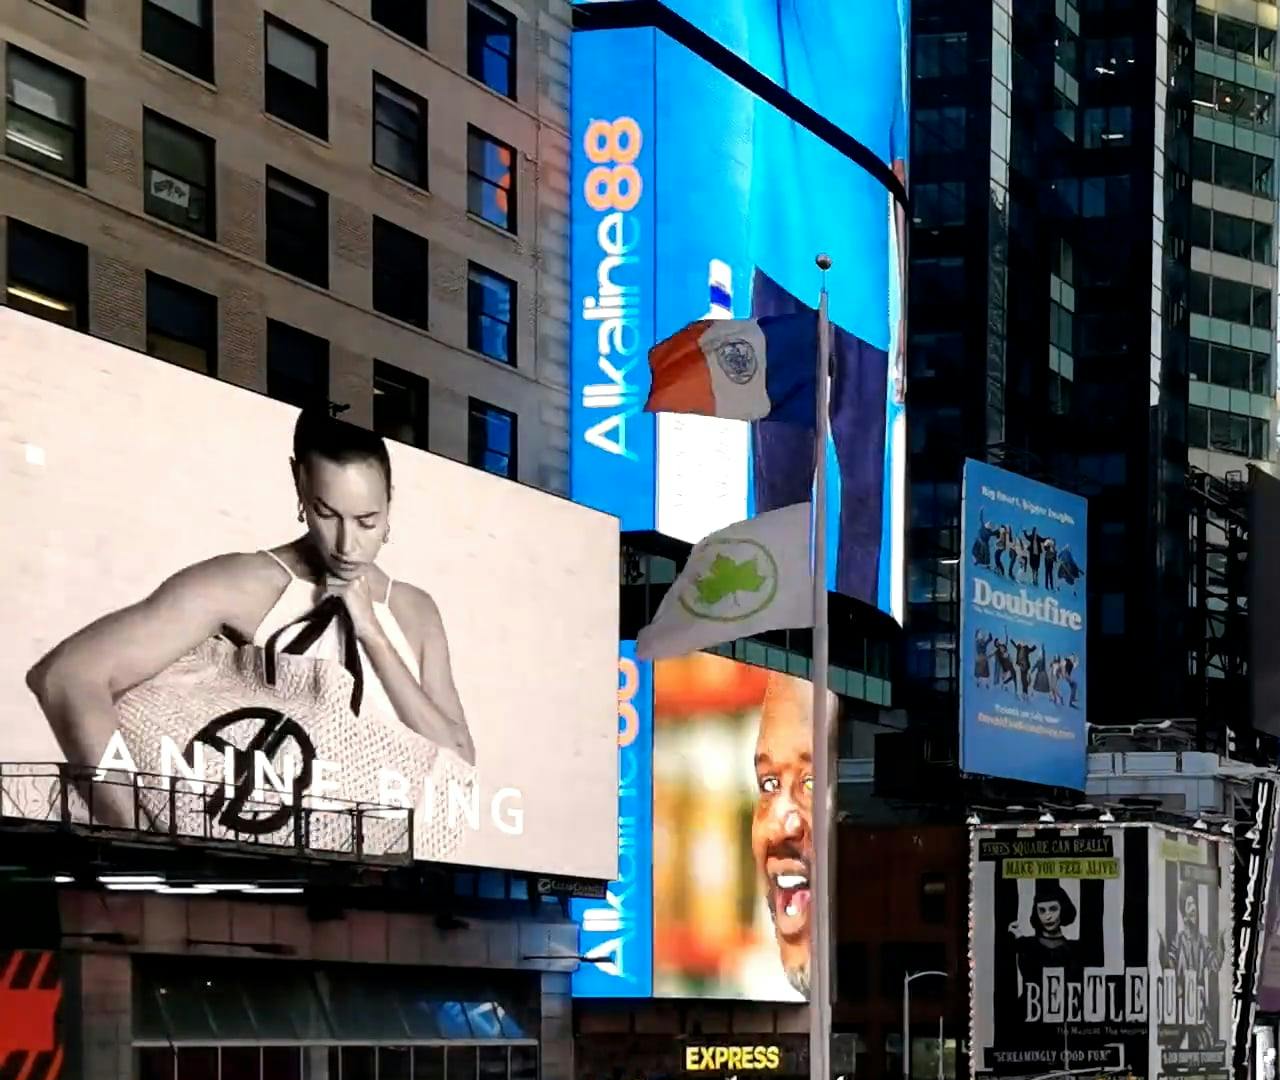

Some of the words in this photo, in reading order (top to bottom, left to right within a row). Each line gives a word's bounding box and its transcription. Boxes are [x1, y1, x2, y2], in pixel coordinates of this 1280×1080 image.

[583, 115, 643, 461] Alkaline88
[973, 578, 1082, 630] Doubtfire
[93, 729, 358, 811] ANINE
[379, 769, 525, 835] BING
[1005, 861, 1033, 877] MAKE
[1036, 861, 1057, 875] YOU
[1012, 840, 1050, 856] SQUARE
[1025, 967, 1148, 1024] BEETLE
[685, 1045, 780, 1070] EXPRESS
